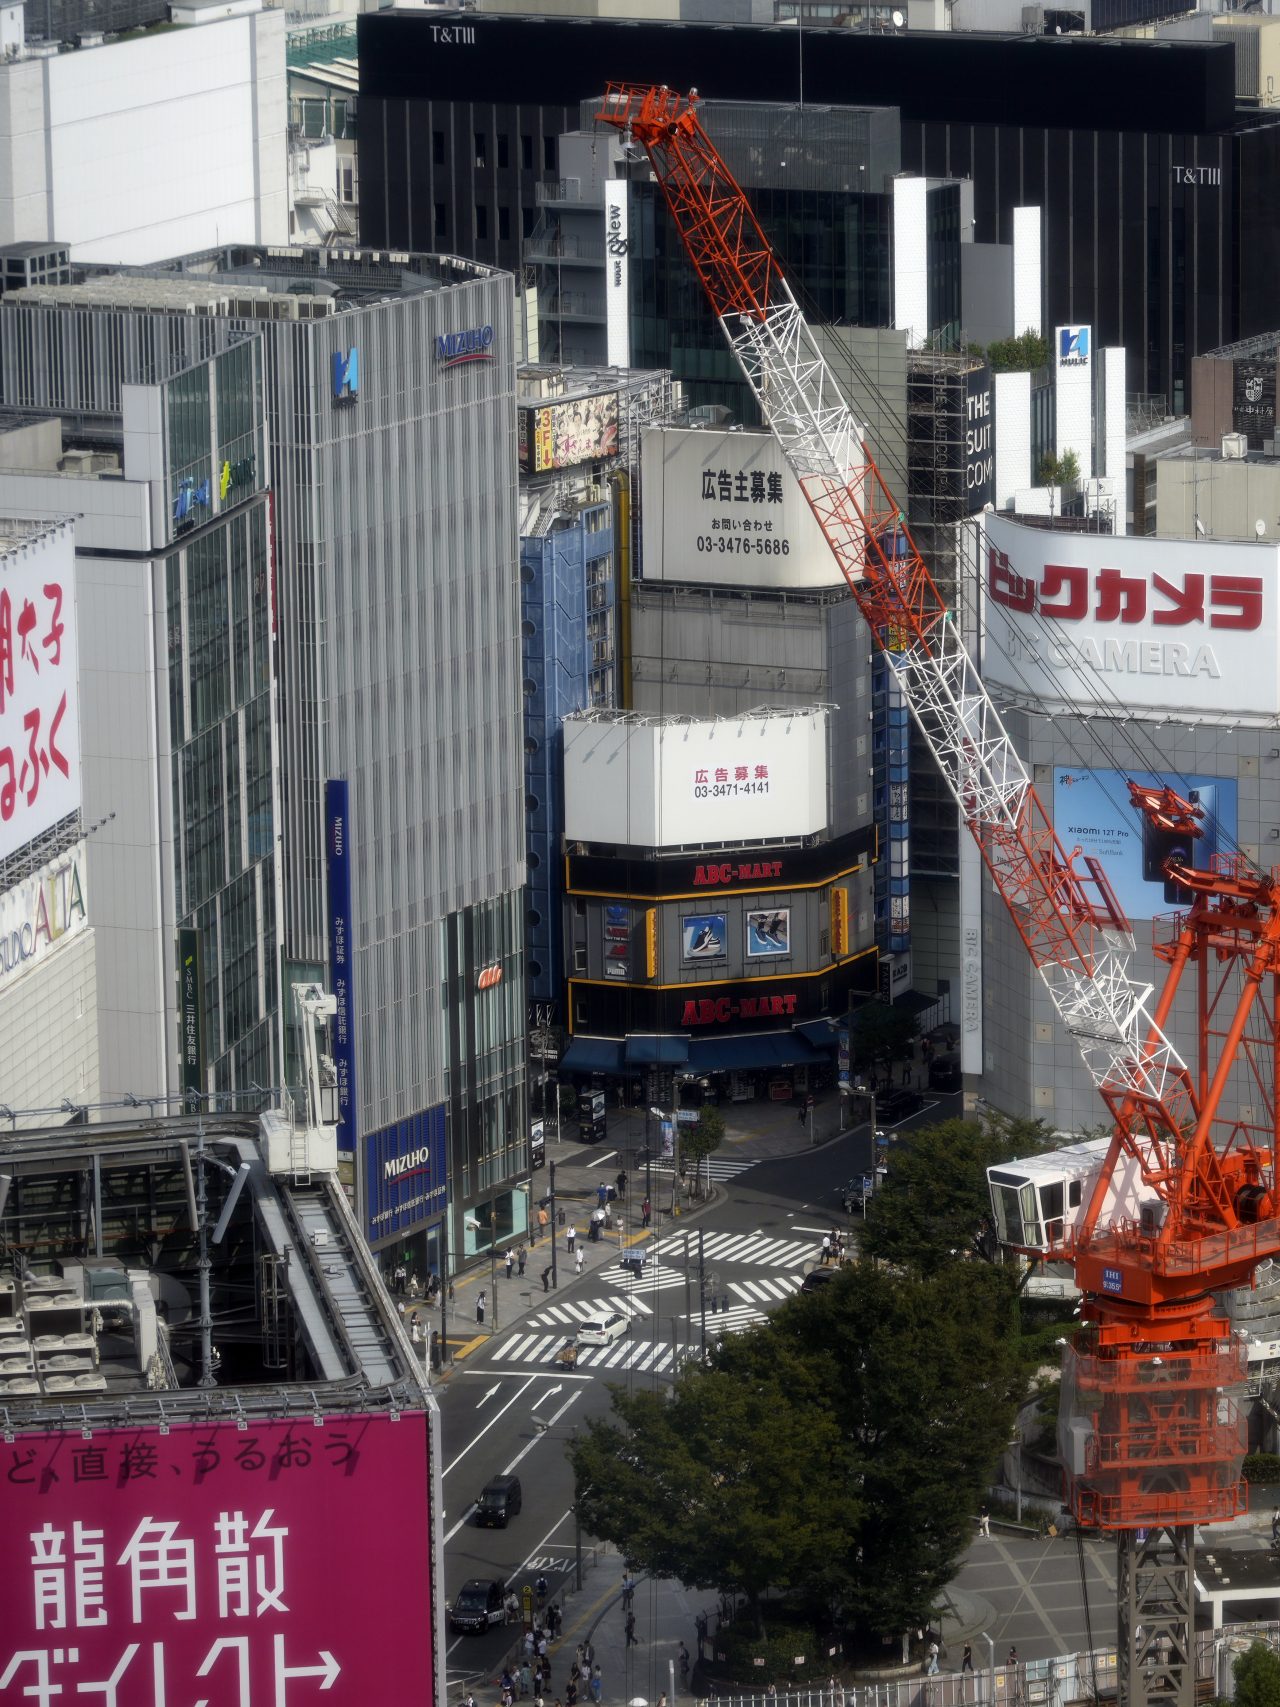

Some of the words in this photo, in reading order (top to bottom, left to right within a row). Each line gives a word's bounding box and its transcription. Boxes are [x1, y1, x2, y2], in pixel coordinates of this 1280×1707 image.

[436, 325, 493, 359] MIZUHO
[1060, 358, 1088, 367] HULIC
[966, 391, 990, 421] THE
[966, 424, 991, 456] SUIT
[702, 468, 783, 504] 広告主募集
[712, 518, 773, 532] お問い合わせ
[697, 536, 790, 555] 03-3476-5686
[989, 547, 1263, 631] ビックカメラ
[1048, 636, 1221, 678] CAMERA
[694, 781, 769, 798] 03-3471-4141
[695, 764, 769, 784] 広告募集
[335, 816, 343, 856] MIZUHO
[1102, 828, 1116, 837] 12T
[1117, 830, 1129, 838] Pro
[693, 862, 783, 886] ABC-MART
[33, 861, 86, 955] ALTA
[335, 917, 345, 964] みずほ証券
[337, 978, 347, 1045] みずほ信託銀行
[682, 994, 797, 1026] ABC-MART
[186, 1004, 196, 1066] 三井住友銀行
[339, 1058, 348, 1106] みずほ銀行
[384, 1147, 429, 1180] MIZUHO
[1105, 1270, 1119, 1280] IHI
[30, 1508, 290, 1630] 龍角散
